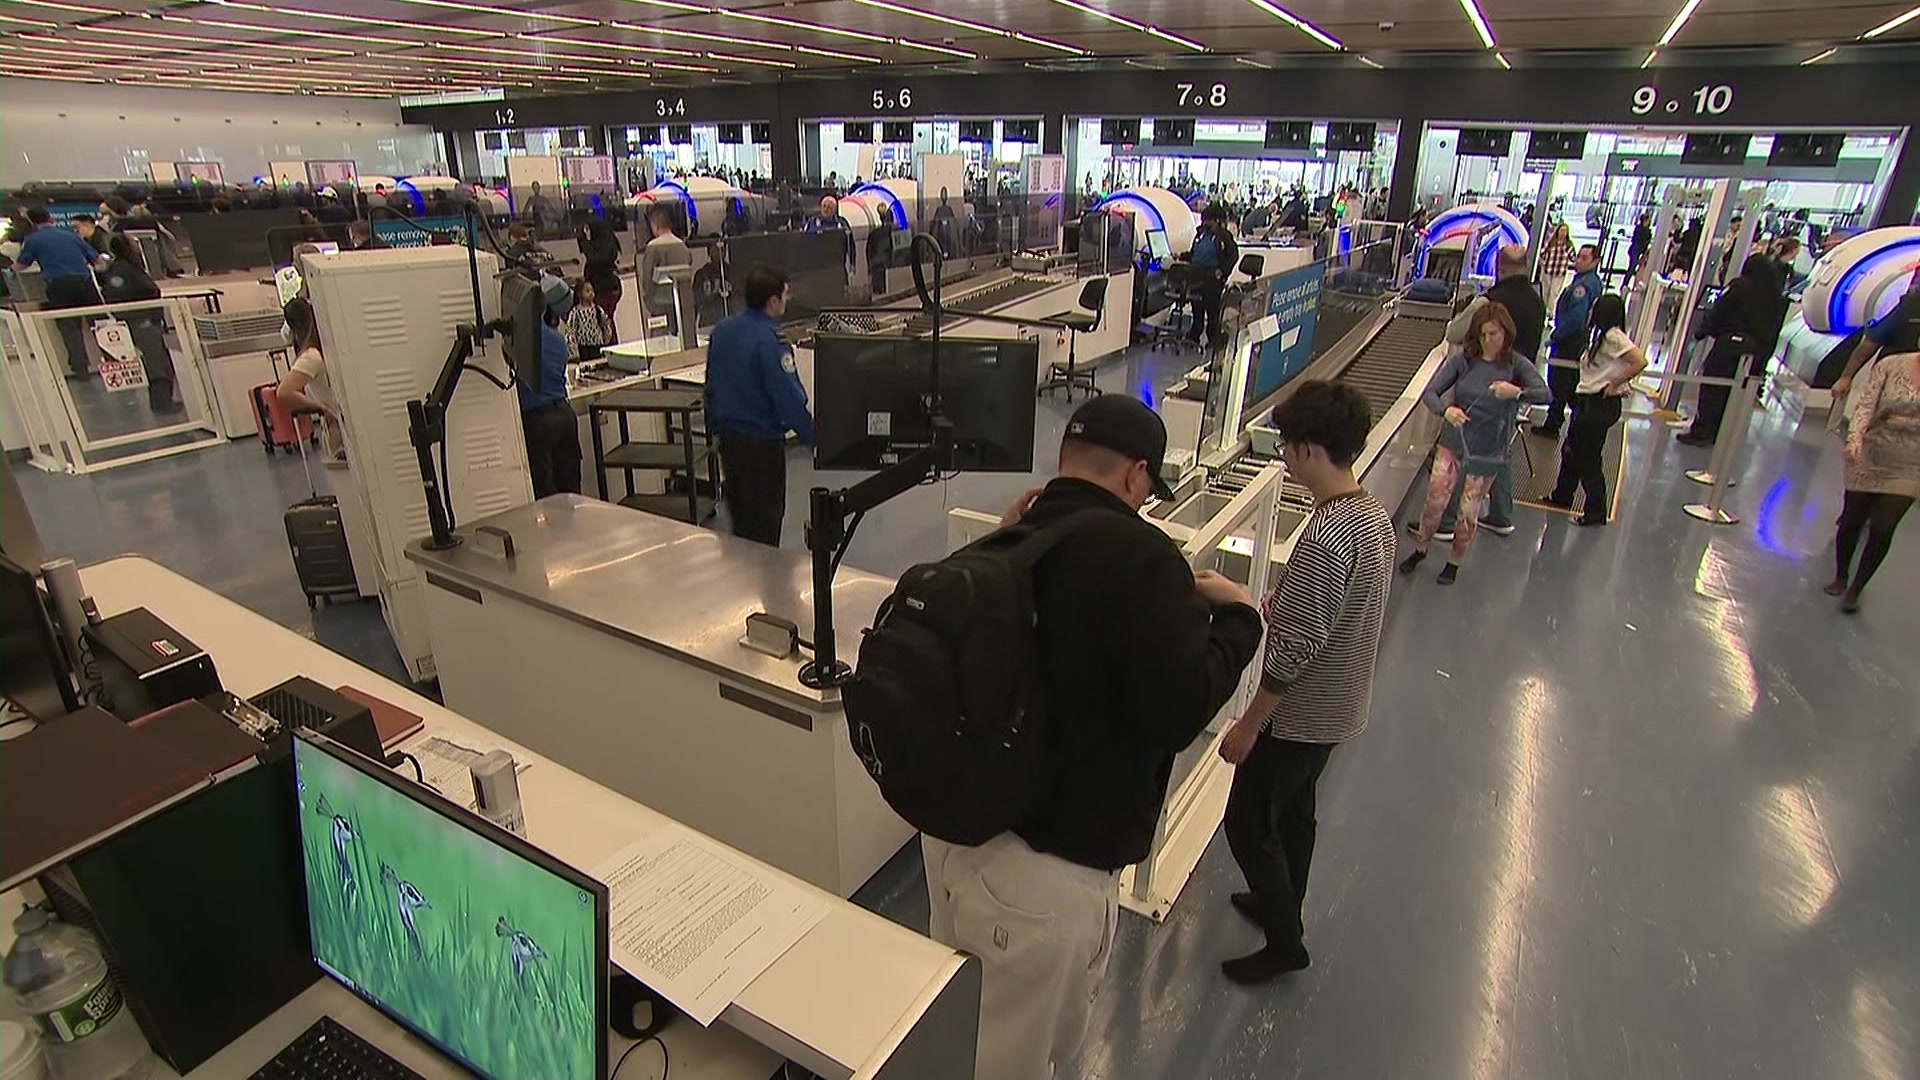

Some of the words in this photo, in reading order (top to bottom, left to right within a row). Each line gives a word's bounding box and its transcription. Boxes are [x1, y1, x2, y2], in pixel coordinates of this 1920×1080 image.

[872, 89, 884, 110] 5
[899, 87, 911, 109] 6
[1177, 83, 1193, 107] 7
[1209, 83, 1227, 107] 8
[1631, 86, 1656, 115] 9
[1692, 85, 1733, 115] 10
